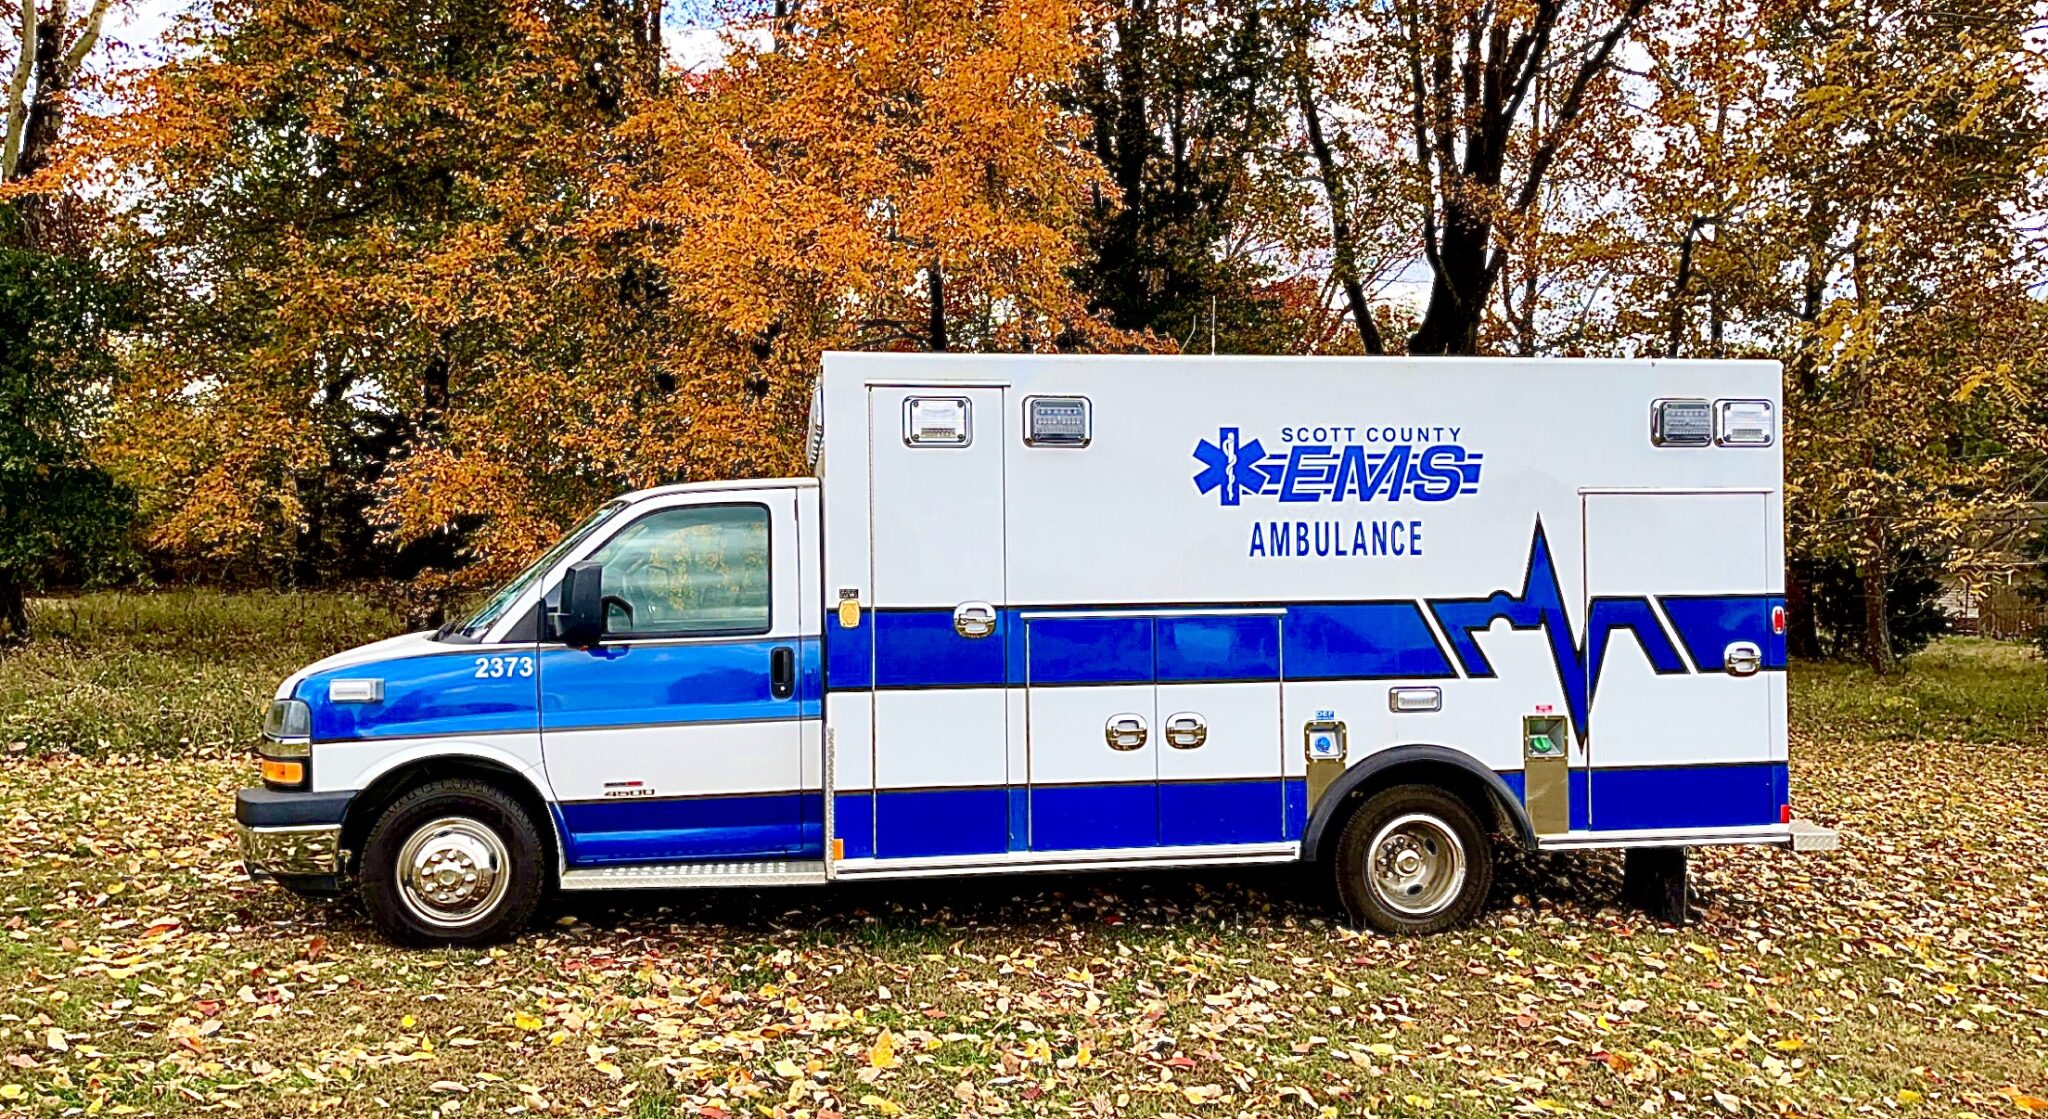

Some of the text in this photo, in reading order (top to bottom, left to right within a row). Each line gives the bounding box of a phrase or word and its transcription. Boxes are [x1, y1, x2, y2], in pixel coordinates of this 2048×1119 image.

[1281, 427, 1462, 442] SCOTT COUNTY
[1278, 445, 1466, 502] EMS
[1249, 520, 1423, 557] AMBULANCE
[475, 656, 534, 678] 2373
[604, 788, 655, 797] 4500
